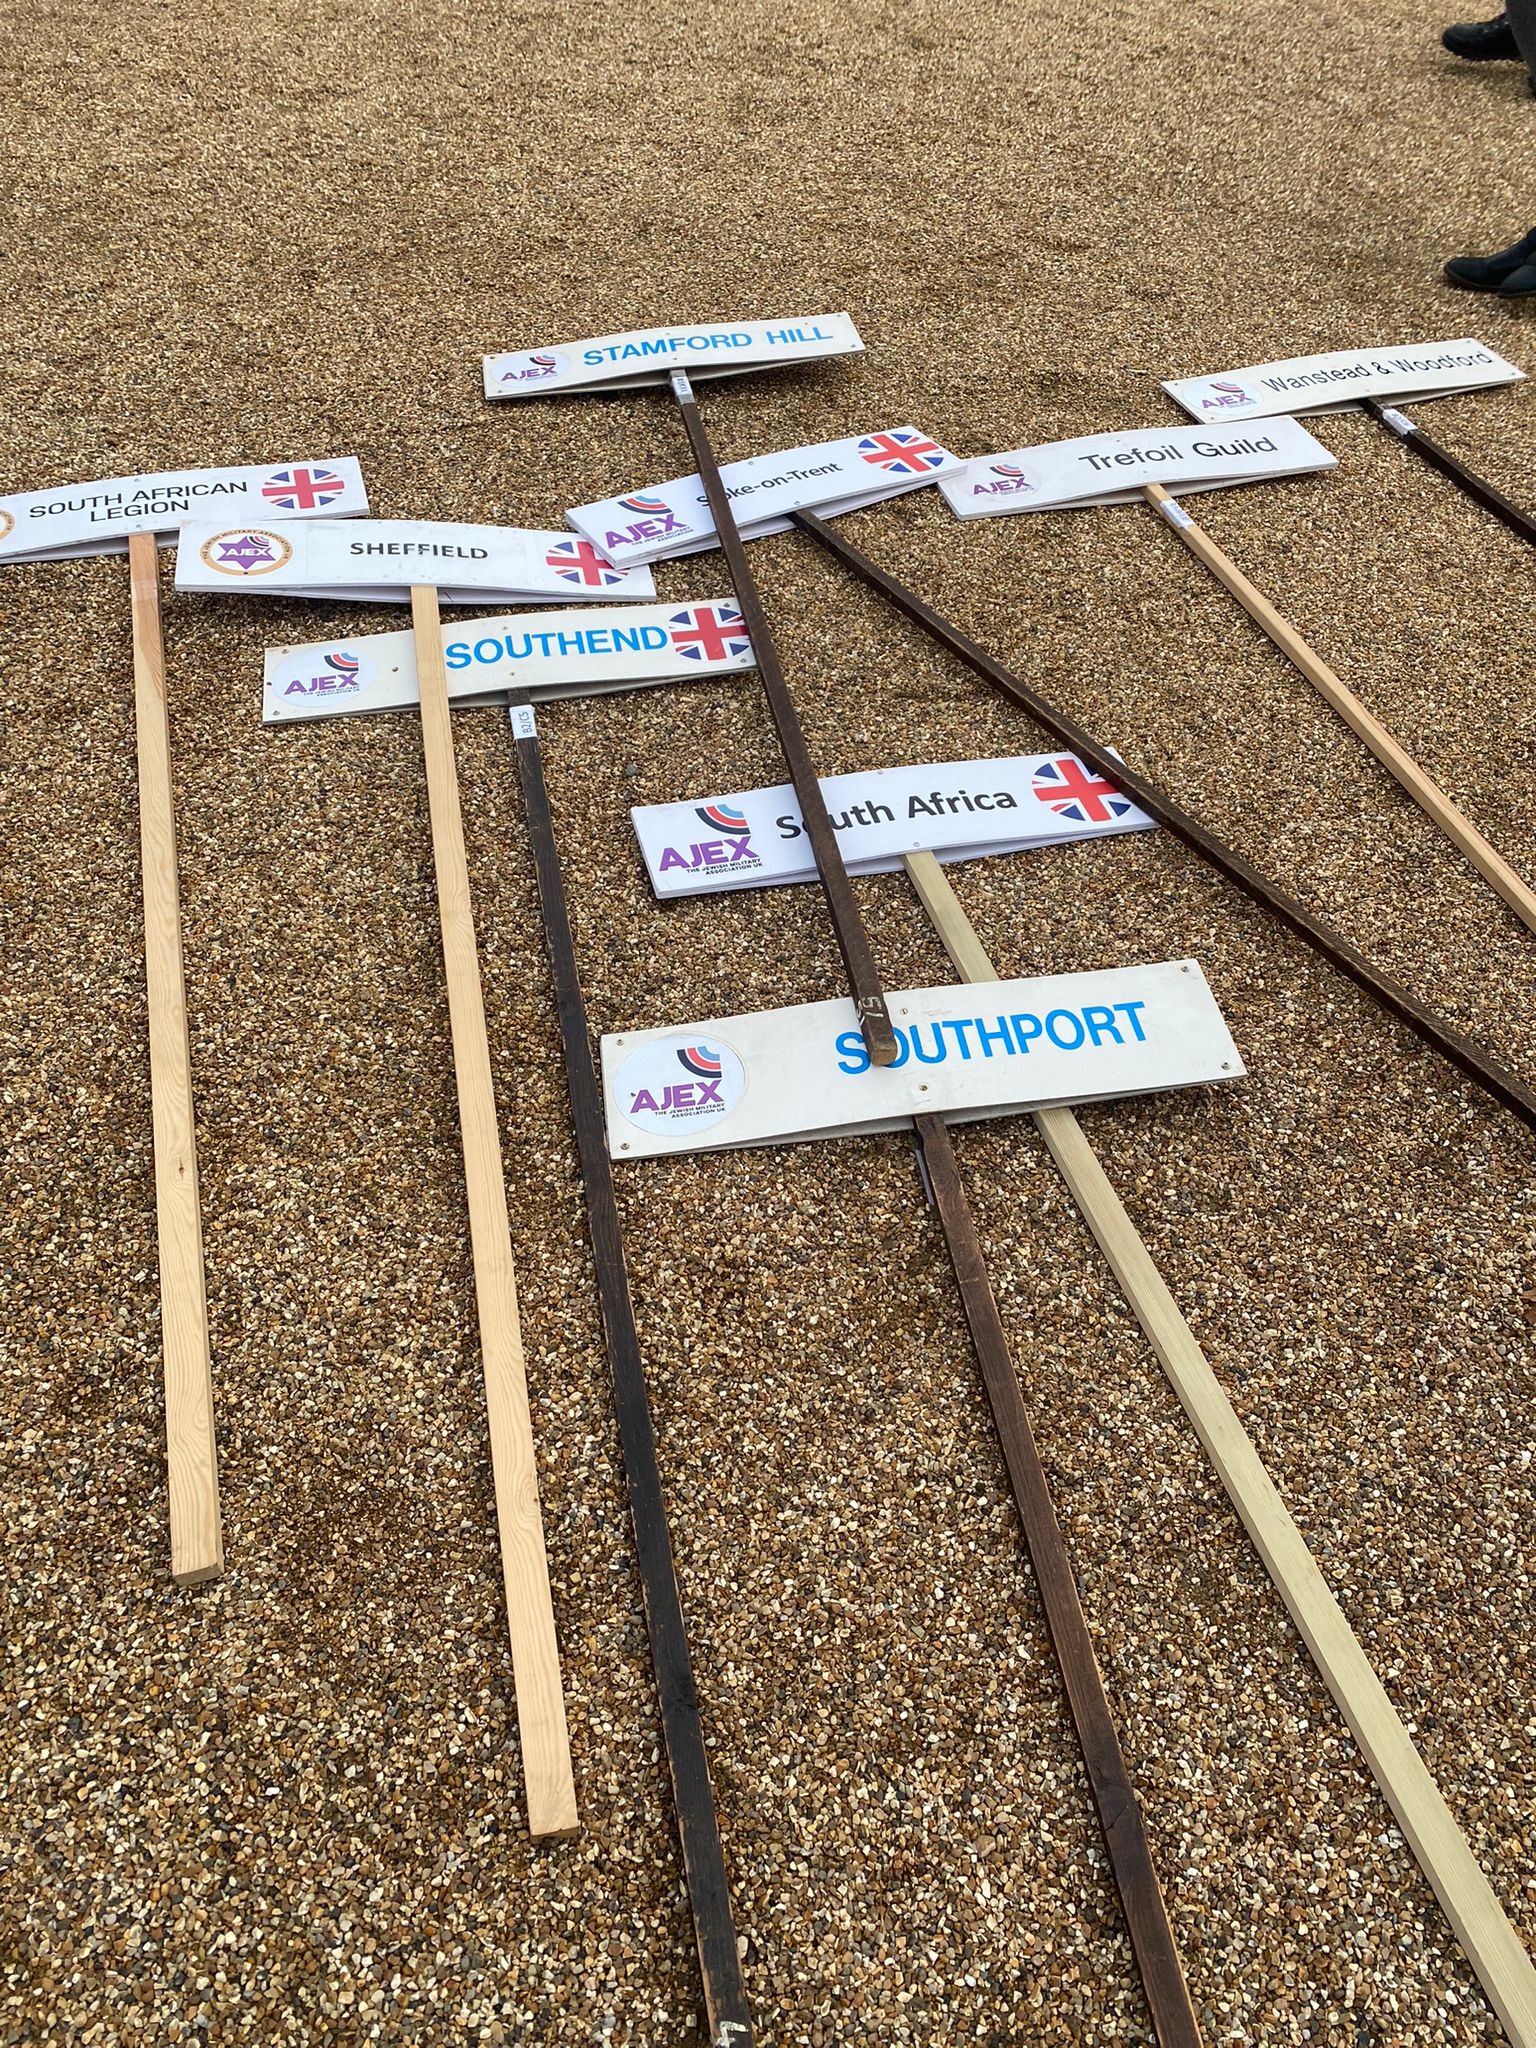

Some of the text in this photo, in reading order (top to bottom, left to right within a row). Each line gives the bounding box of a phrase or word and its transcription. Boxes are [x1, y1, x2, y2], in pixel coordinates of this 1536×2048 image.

[583, 326, 833, 366] STAMFORD HILL
[501, 366, 557, 381] AJEX
[1261, 351, 1494, 392] Wanstead & Woodford
[1202, 393, 1253, 408] AJEX
[1078, 436, 1278, 471] Trefoil Guild
[696, 463, 843, 507] Ske-on-Trent
[974, 477, 1031, 495] AJEX
[29, 481, 248, 518] SOUTH AFRICAN
[90, 500, 189, 522] LEGION
[605, 513, 687, 548] AJEX
[225, 548, 268, 556] AJEX
[350, 542, 488, 559] SHEFFIELD
[445, 625, 668, 669] SOUTHEND
[284, 672, 360, 695] AJEX
[775, 789, 1018, 840] Suth Africa
[659, 835, 759, 872] AJEX
[702, 863, 729, 871] JEWISH
[730, 858, 761, 867] MILITARY
[705, 864, 752, 875] ASSOCIATION
[630, 1079, 724, 1114] AJEX
[669, 1107, 694, 1115] JEWISH
[696, 1103, 725, 1111] MILITARY
[671, 1108, 716, 1119] ASSOCIATION
